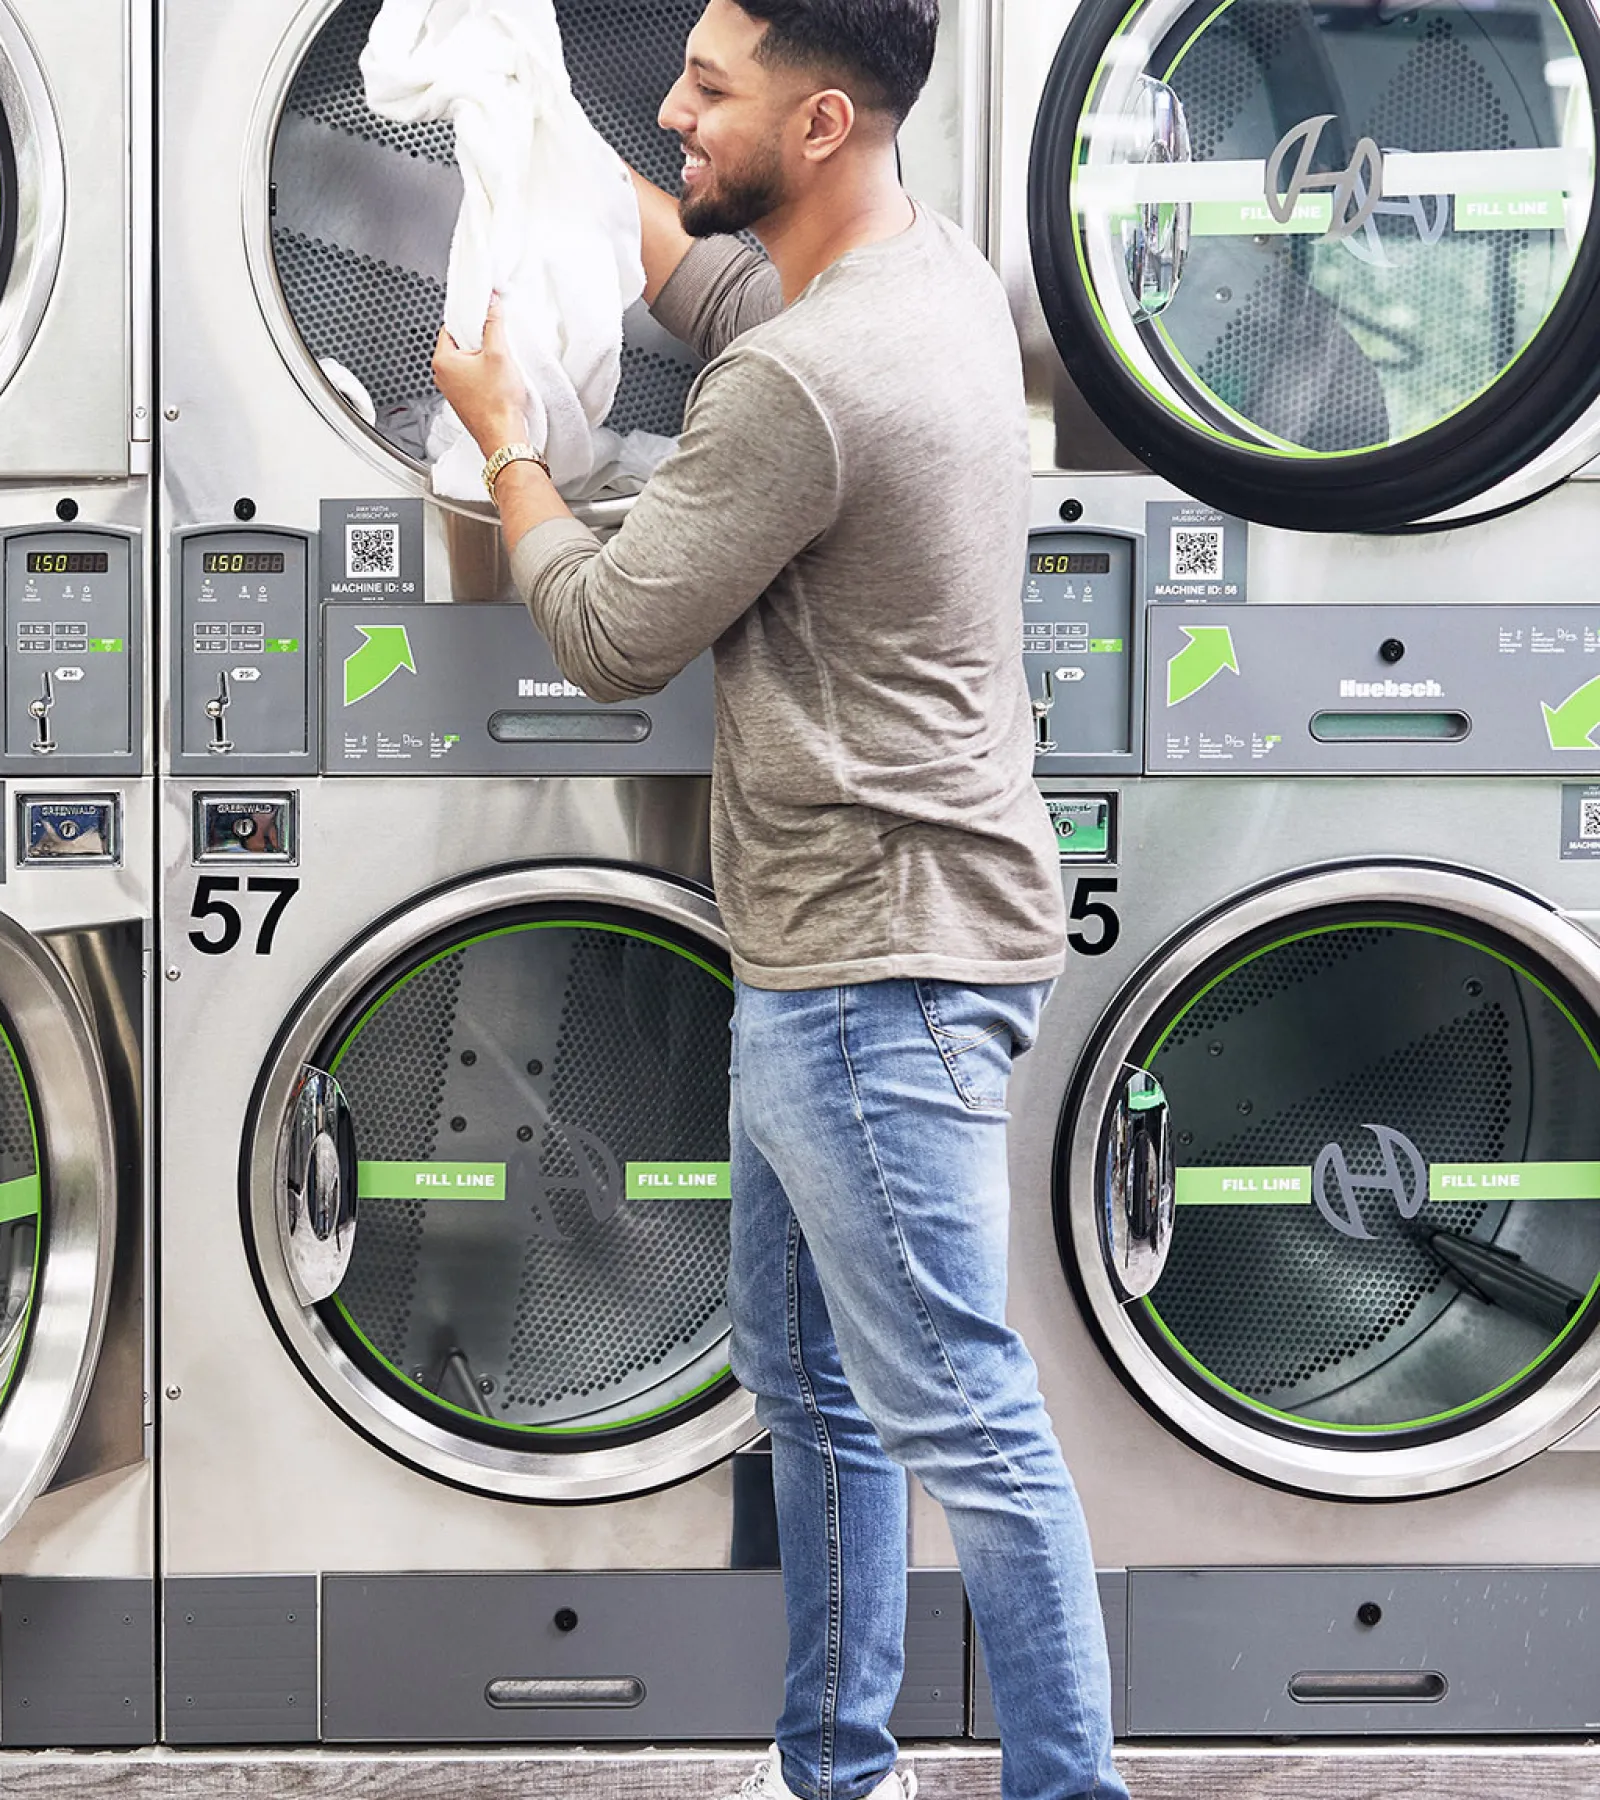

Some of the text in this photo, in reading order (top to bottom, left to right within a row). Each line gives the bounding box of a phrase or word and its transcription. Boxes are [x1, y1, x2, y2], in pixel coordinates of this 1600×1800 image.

[1241, 207, 1271, 220] FIL
[1467, 202, 1548, 215] FILL LINE
[331, 583, 382, 593] MACHINE
[384, 583, 400, 593] ID:
[1155, 585, 1205, 595] MACHINE
[1207, 585, 1222, 595] ID:
[519, 680, 586, 697] Hueb
[189, 876, 300, 955] 57
[1068, 878, 1120, 956] 5
[416, 1174, 495, 1187] FILL LINE
[639, 1174, 717, 1186] FILL LINE
[1222, 1178, 1301, 1191] FILL LINE
[1441, 1174, 1521, 1188] FILL LINE
